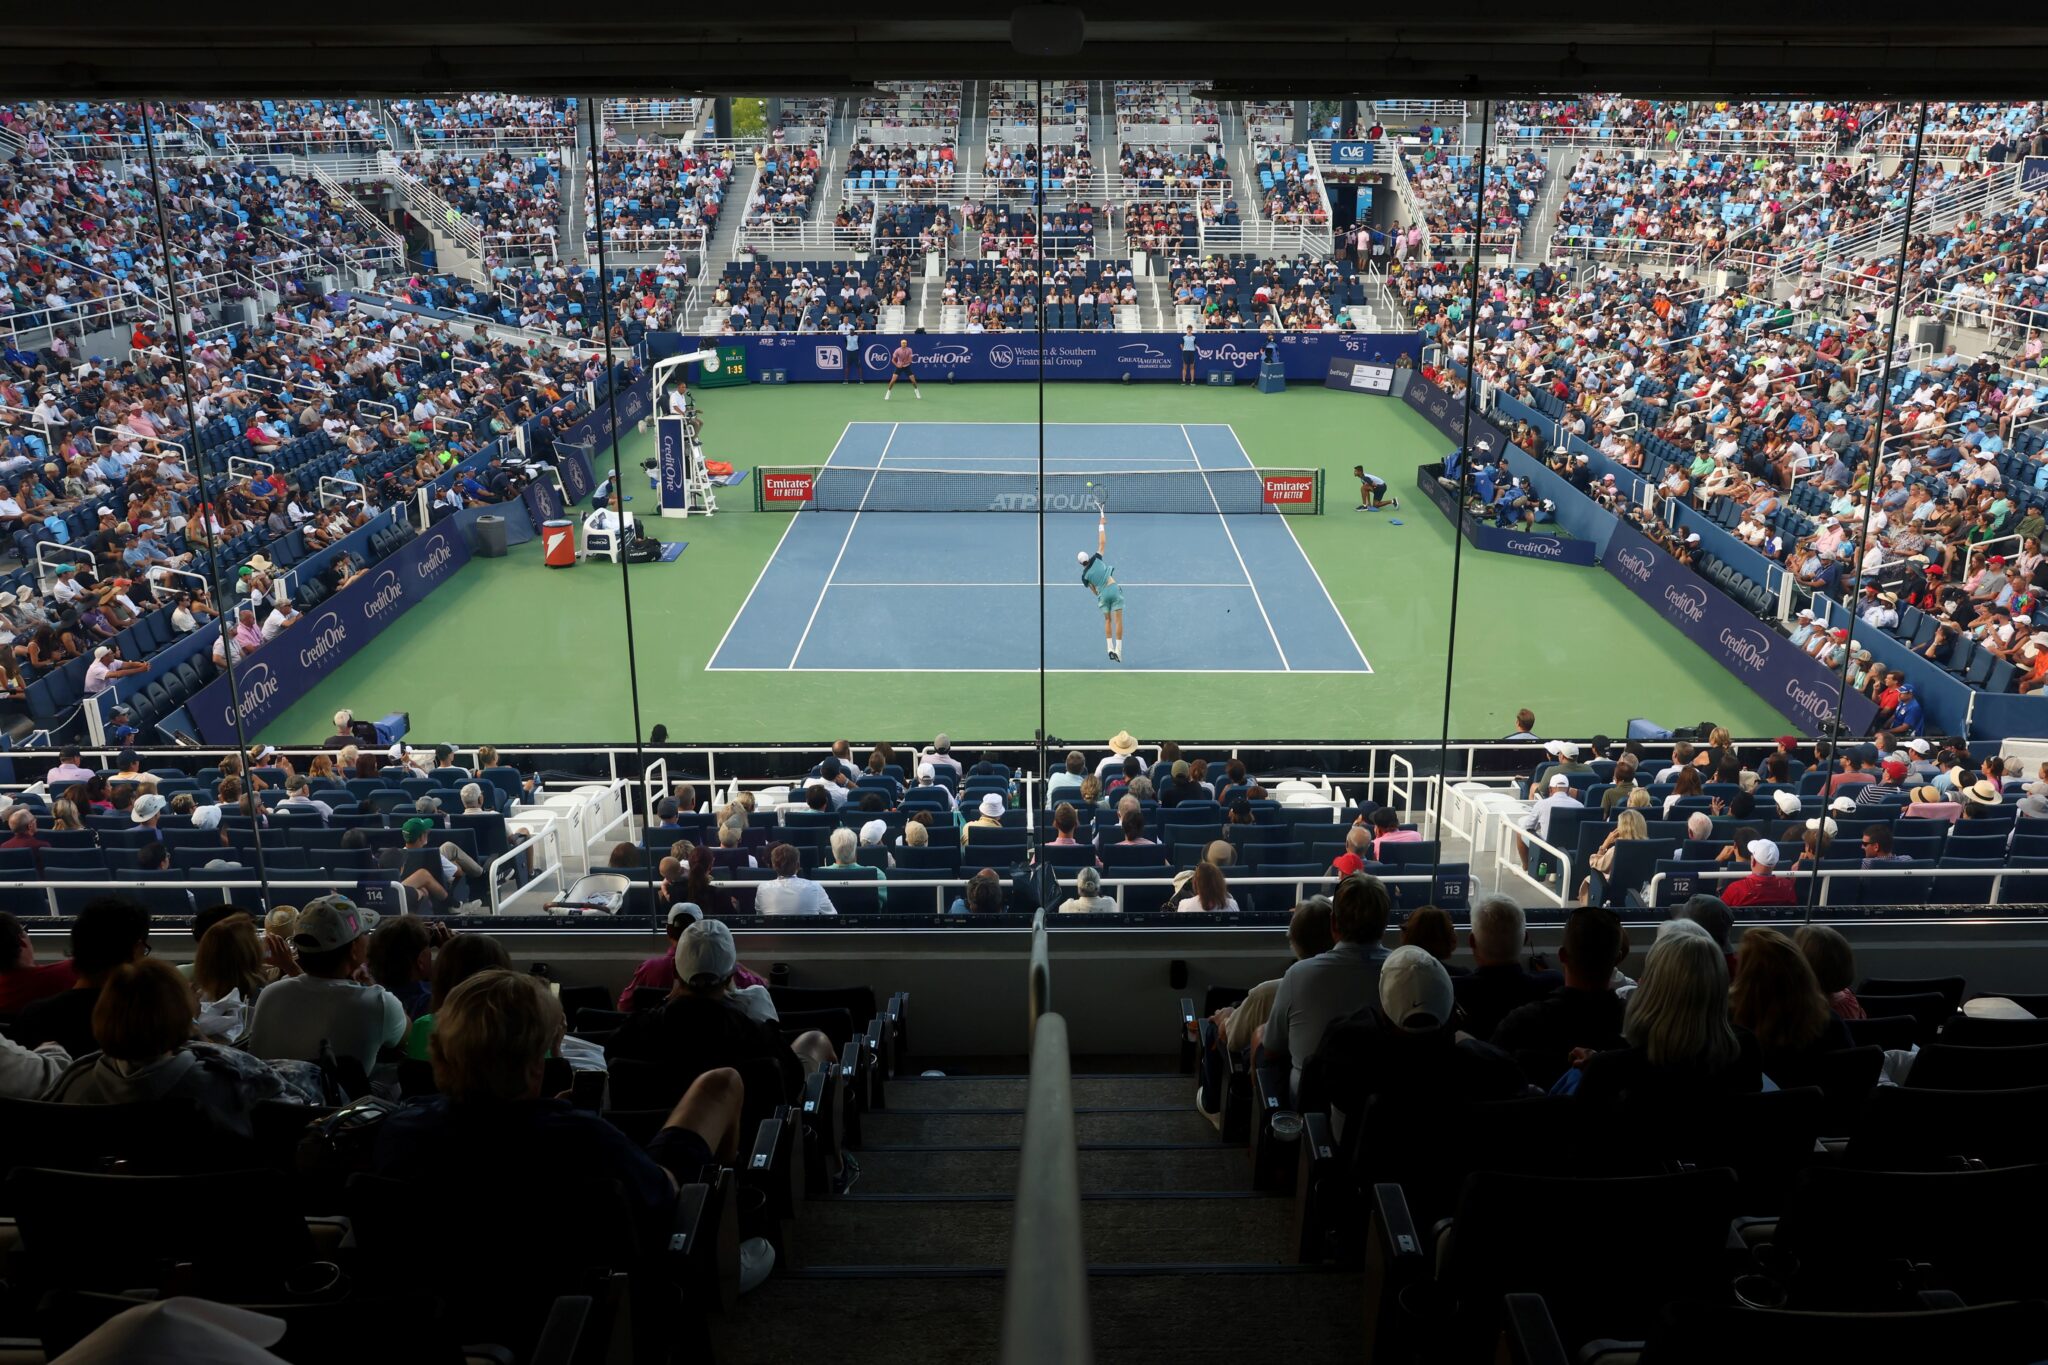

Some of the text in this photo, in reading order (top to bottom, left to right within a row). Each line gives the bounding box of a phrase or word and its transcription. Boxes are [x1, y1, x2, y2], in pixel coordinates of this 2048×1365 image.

[1340, 146, 1364, 157] CVG
[1049, 347, 1057, 356] &
[1059, 346, 1097, 356] Southern
[1345, 341, 1359, 351] 95
[870, 352, 888, 362] P&G
[1215, 343, 1259, 368] Kroger
[1016, 356, 1083, 368] Finanial Group
[726, 364, 743, 375] 1:35
[1329, 368, 1349, 379] betway
[766, 478, 809, 488] Emirates
[1266, 481, 1310, 491] Emirates
[773, 489, 804, 497] FLY BETTER
[1273, 491, 1304, 499] FLY BETTER
[989, 493, 1097, 510] ATP TOUR
[1444, 885, 1460, 895] 113
[1673, 881, 1689, 891] 112
[366, 891, 383, 901] 114
